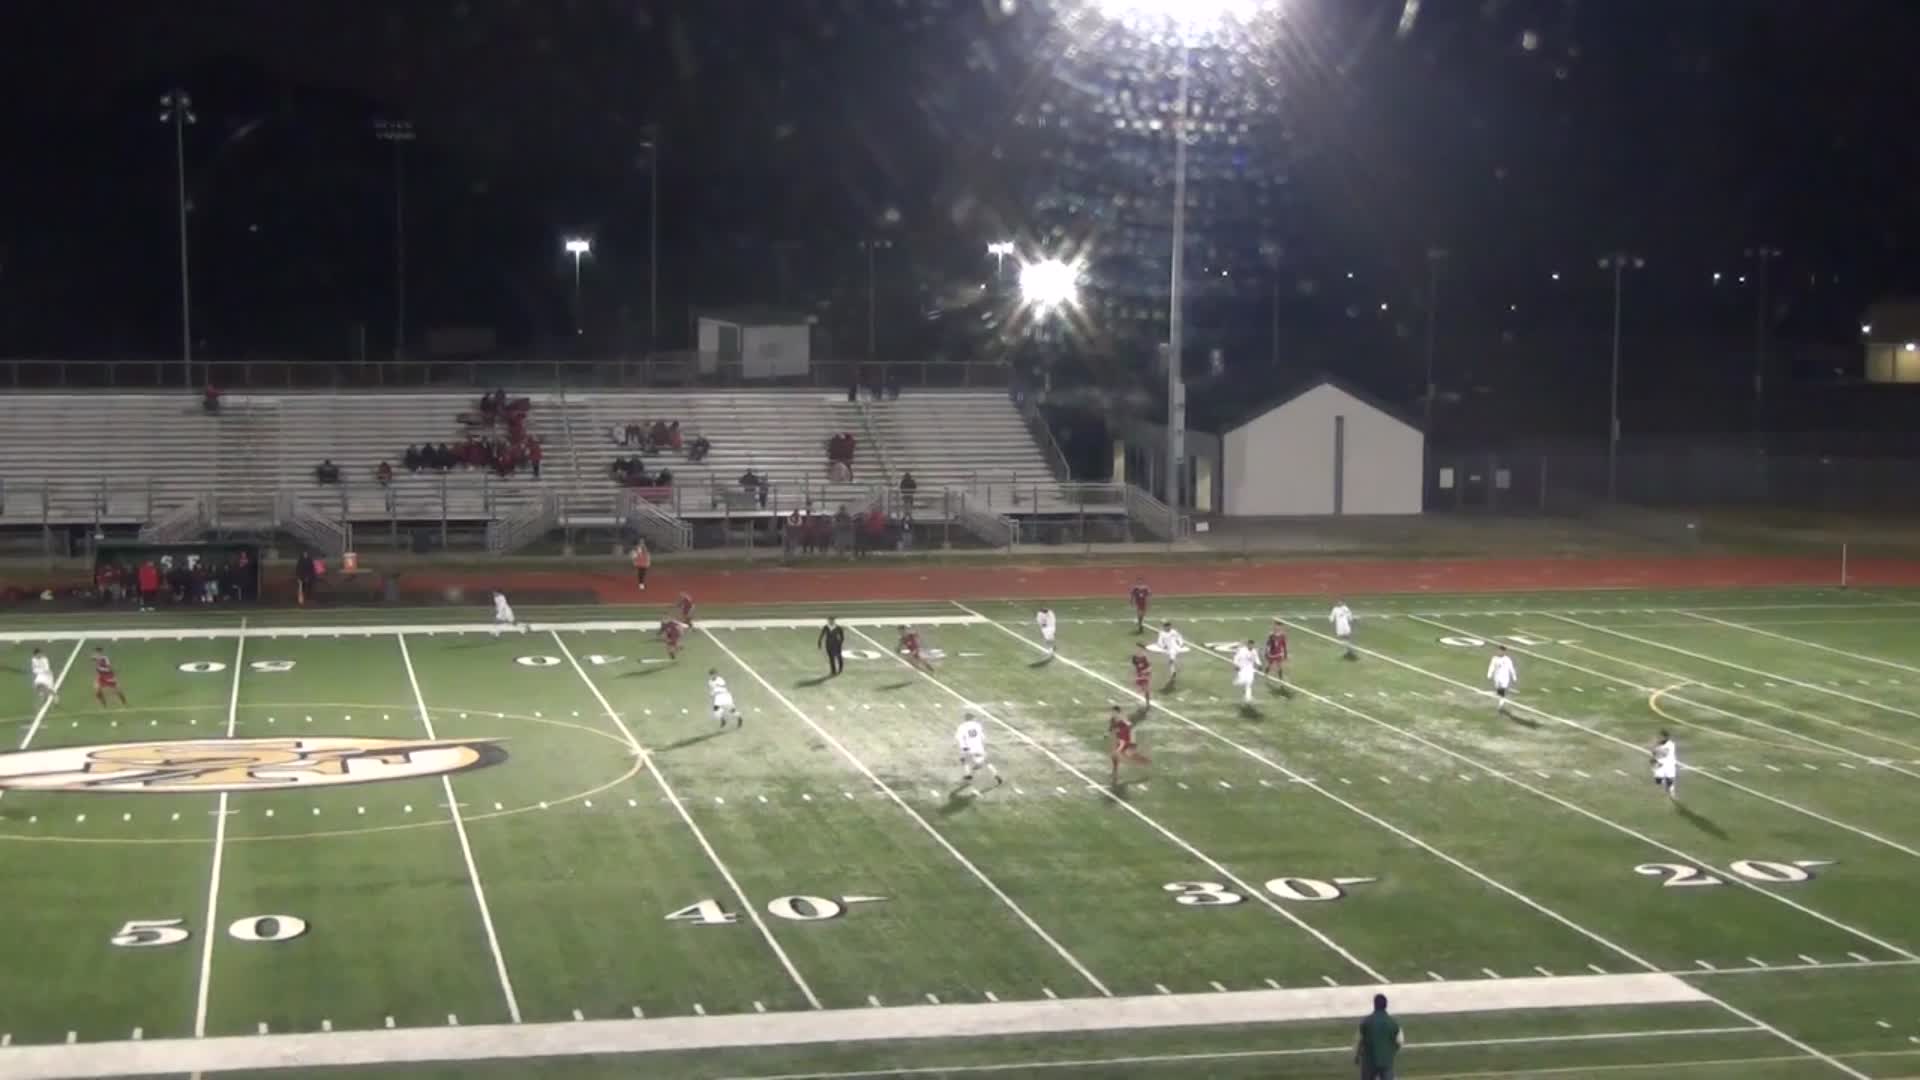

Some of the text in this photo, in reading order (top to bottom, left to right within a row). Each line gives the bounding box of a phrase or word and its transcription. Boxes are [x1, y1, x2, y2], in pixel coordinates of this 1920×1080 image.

[1633, 859, 1810, 887] 20
[1161, 876, 1342, 905] 30
[663, 894, 842, 924] 40
[110, 913, 308, 946] 50
